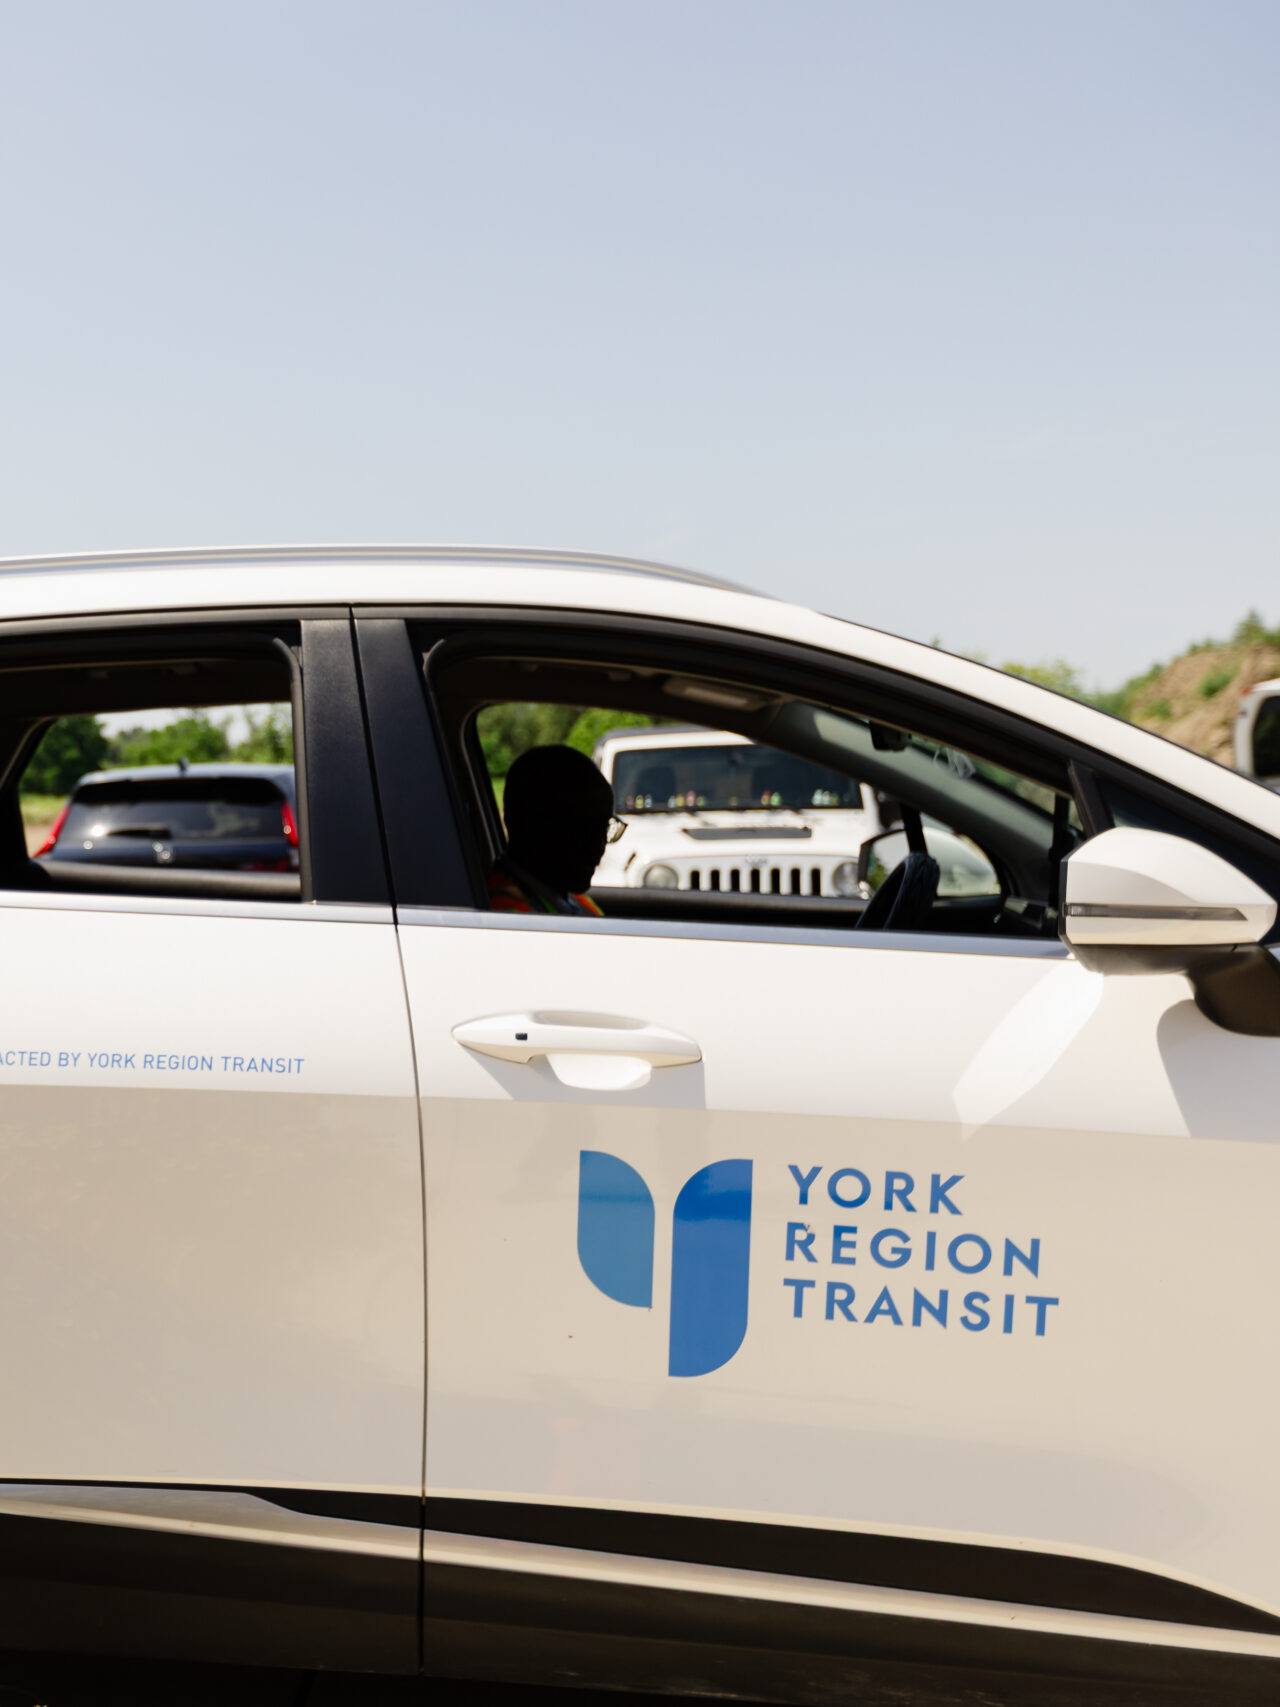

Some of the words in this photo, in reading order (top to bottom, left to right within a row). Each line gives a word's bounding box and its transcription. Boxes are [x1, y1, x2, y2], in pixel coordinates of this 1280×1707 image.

[57, 1052, 81, 1068] BY
[87, 1052, 137, 1069] YORK
[143, 1053, 214, 1072] REGION
[221, 1056, 305, 1074] TRANSIT
[787, 1164, 966, 1216] YORK
[784, 1221, 1041, 1279] REGION
[782, 1277, 1060, 1337] TRANSIT
